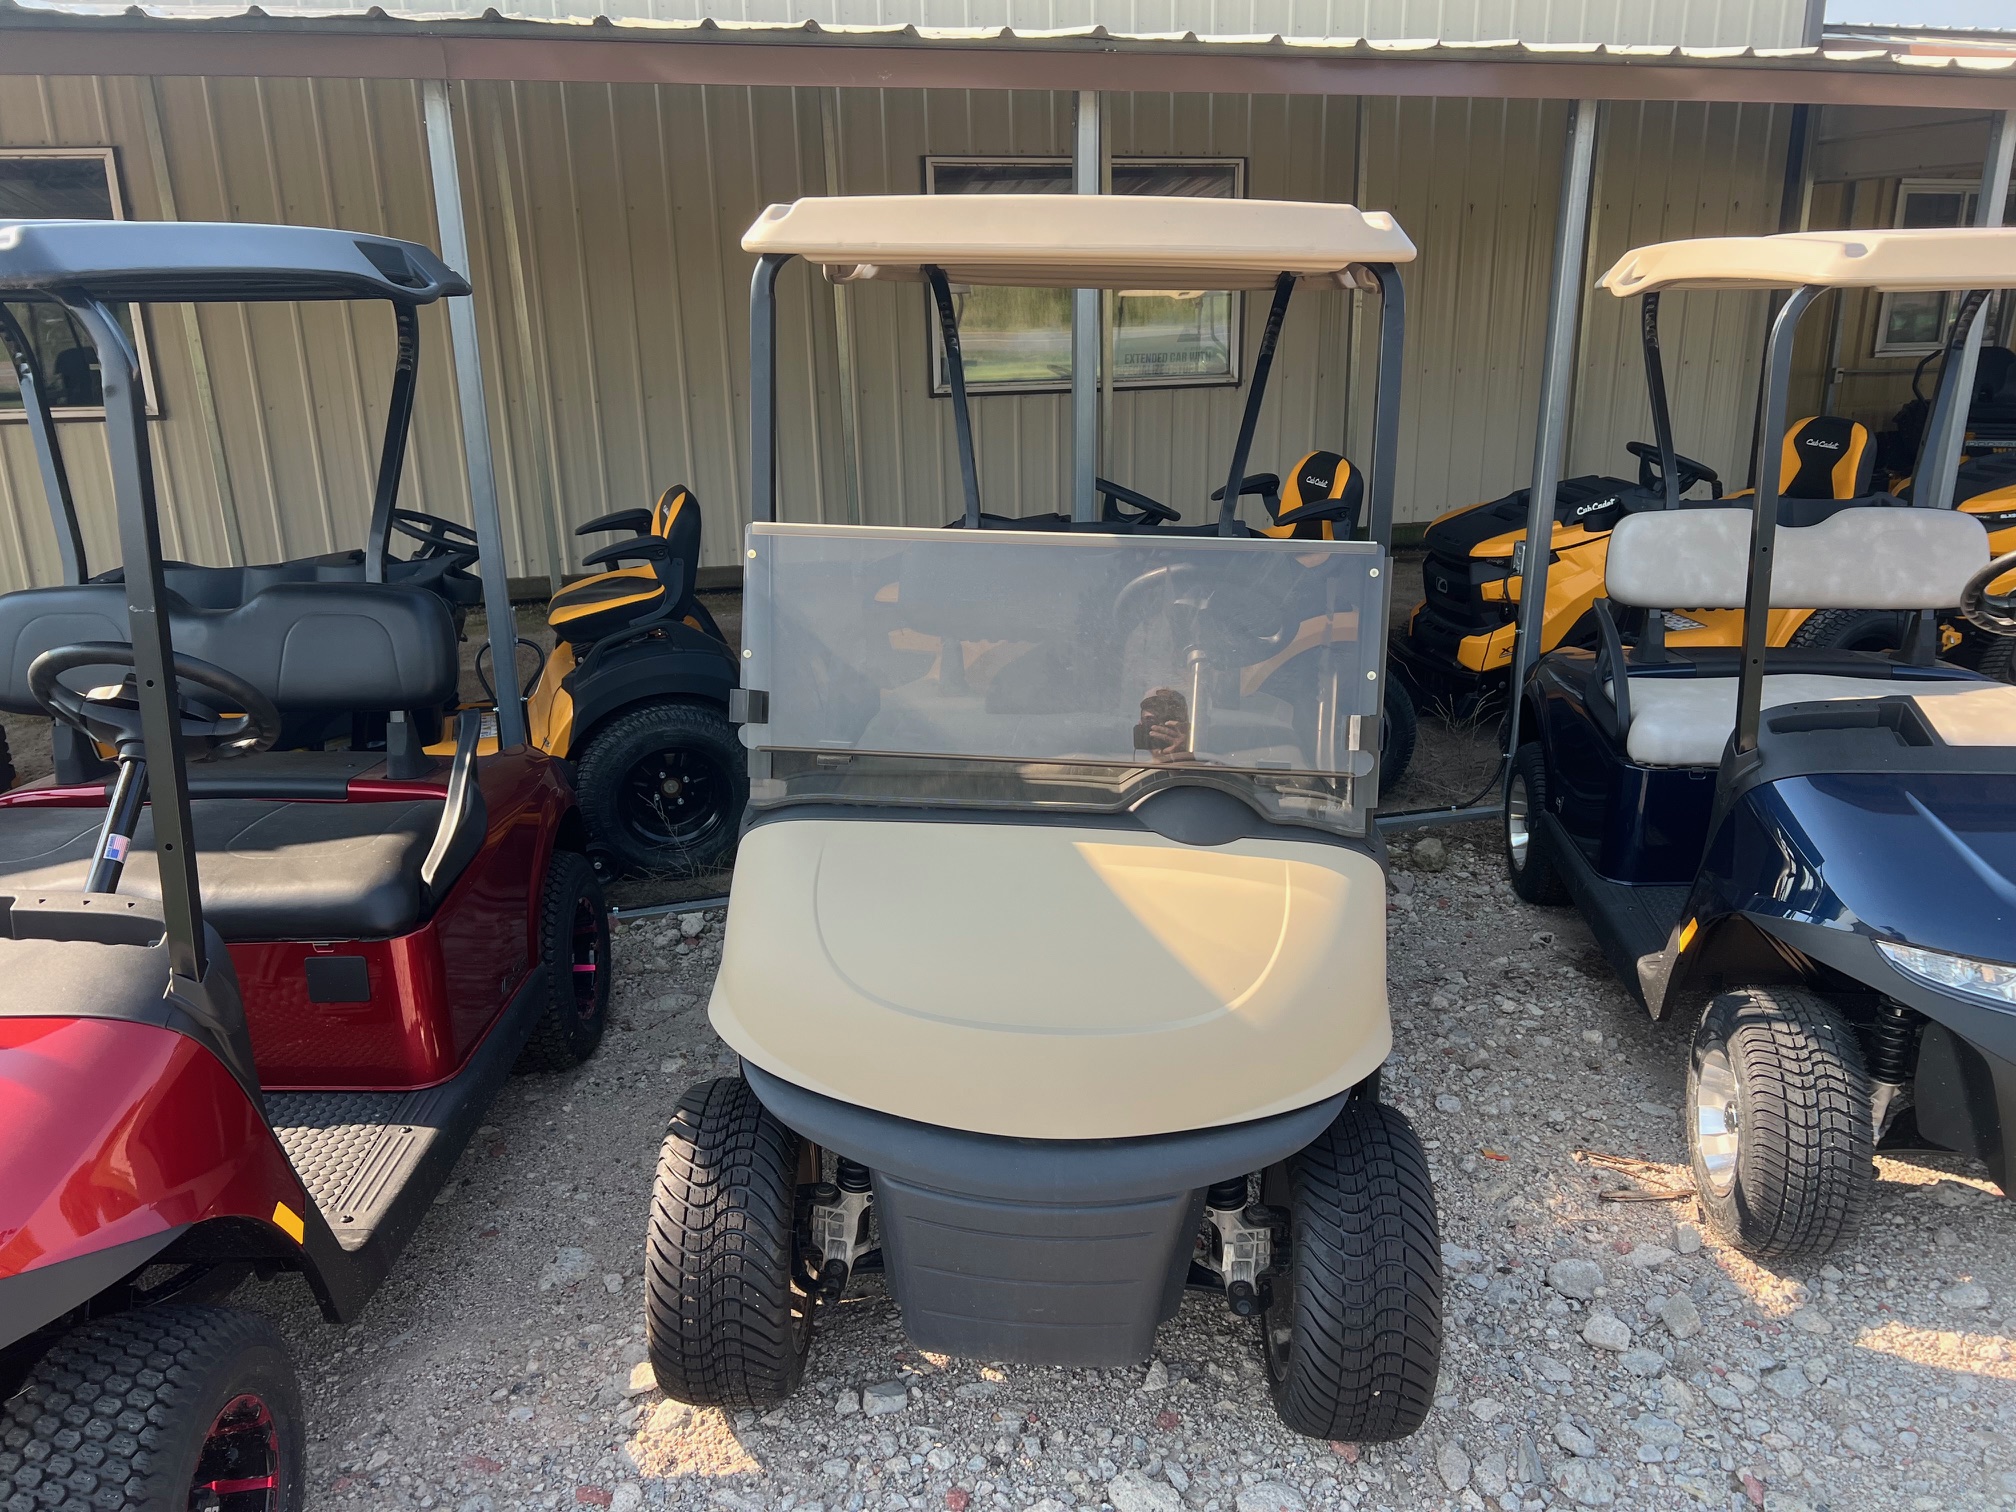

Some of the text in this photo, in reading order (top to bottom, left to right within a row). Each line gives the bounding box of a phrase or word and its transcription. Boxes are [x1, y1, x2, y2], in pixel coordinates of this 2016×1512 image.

[1124, 353, 1168, 365] EXTENDED
[1170, 352, 1188, 363] CAB
[1577, 498, 1616, 515] Cub Cadet
